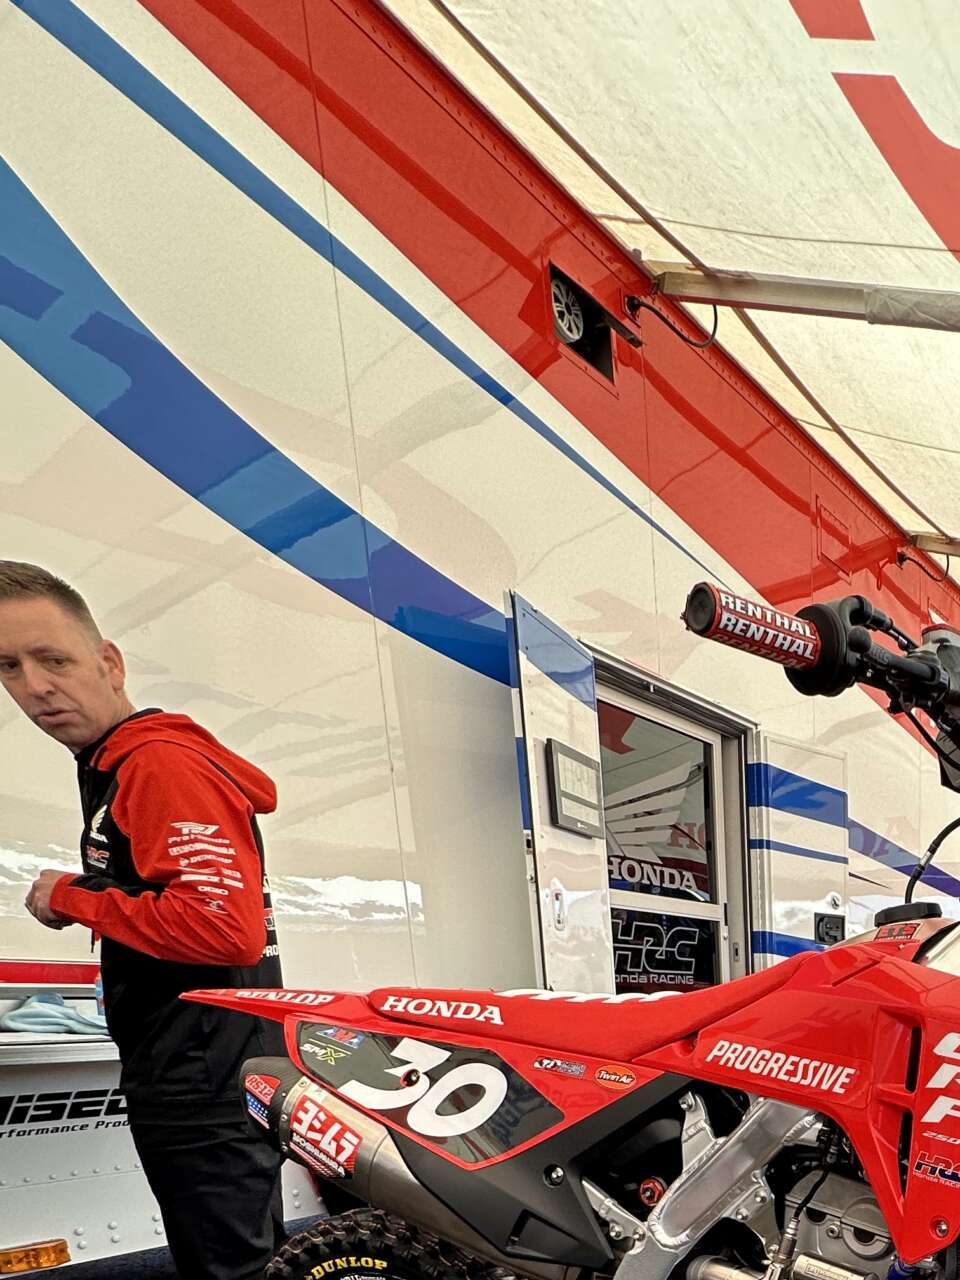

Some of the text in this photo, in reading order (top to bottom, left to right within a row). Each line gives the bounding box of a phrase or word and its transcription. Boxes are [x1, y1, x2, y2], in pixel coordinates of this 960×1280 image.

[720, 589, 817, 639] RENTHAL
[718, 611, 816, 660] RENTHAL
[234, 990, 336, 1007] DUNLOP
[650, 975, 694, 986] RACING
[380, 995, 505, 1026] HONDA
[337, 1036, 509, 1138] 30
[599, 1069, 634, 1084] Twin Air
[705, 1039, 857, 1095] PROGRESSIVE
[291, 1100, 360, 1165] ヨシムラ
[310, 1256, 388, 1280] DUNLOP
